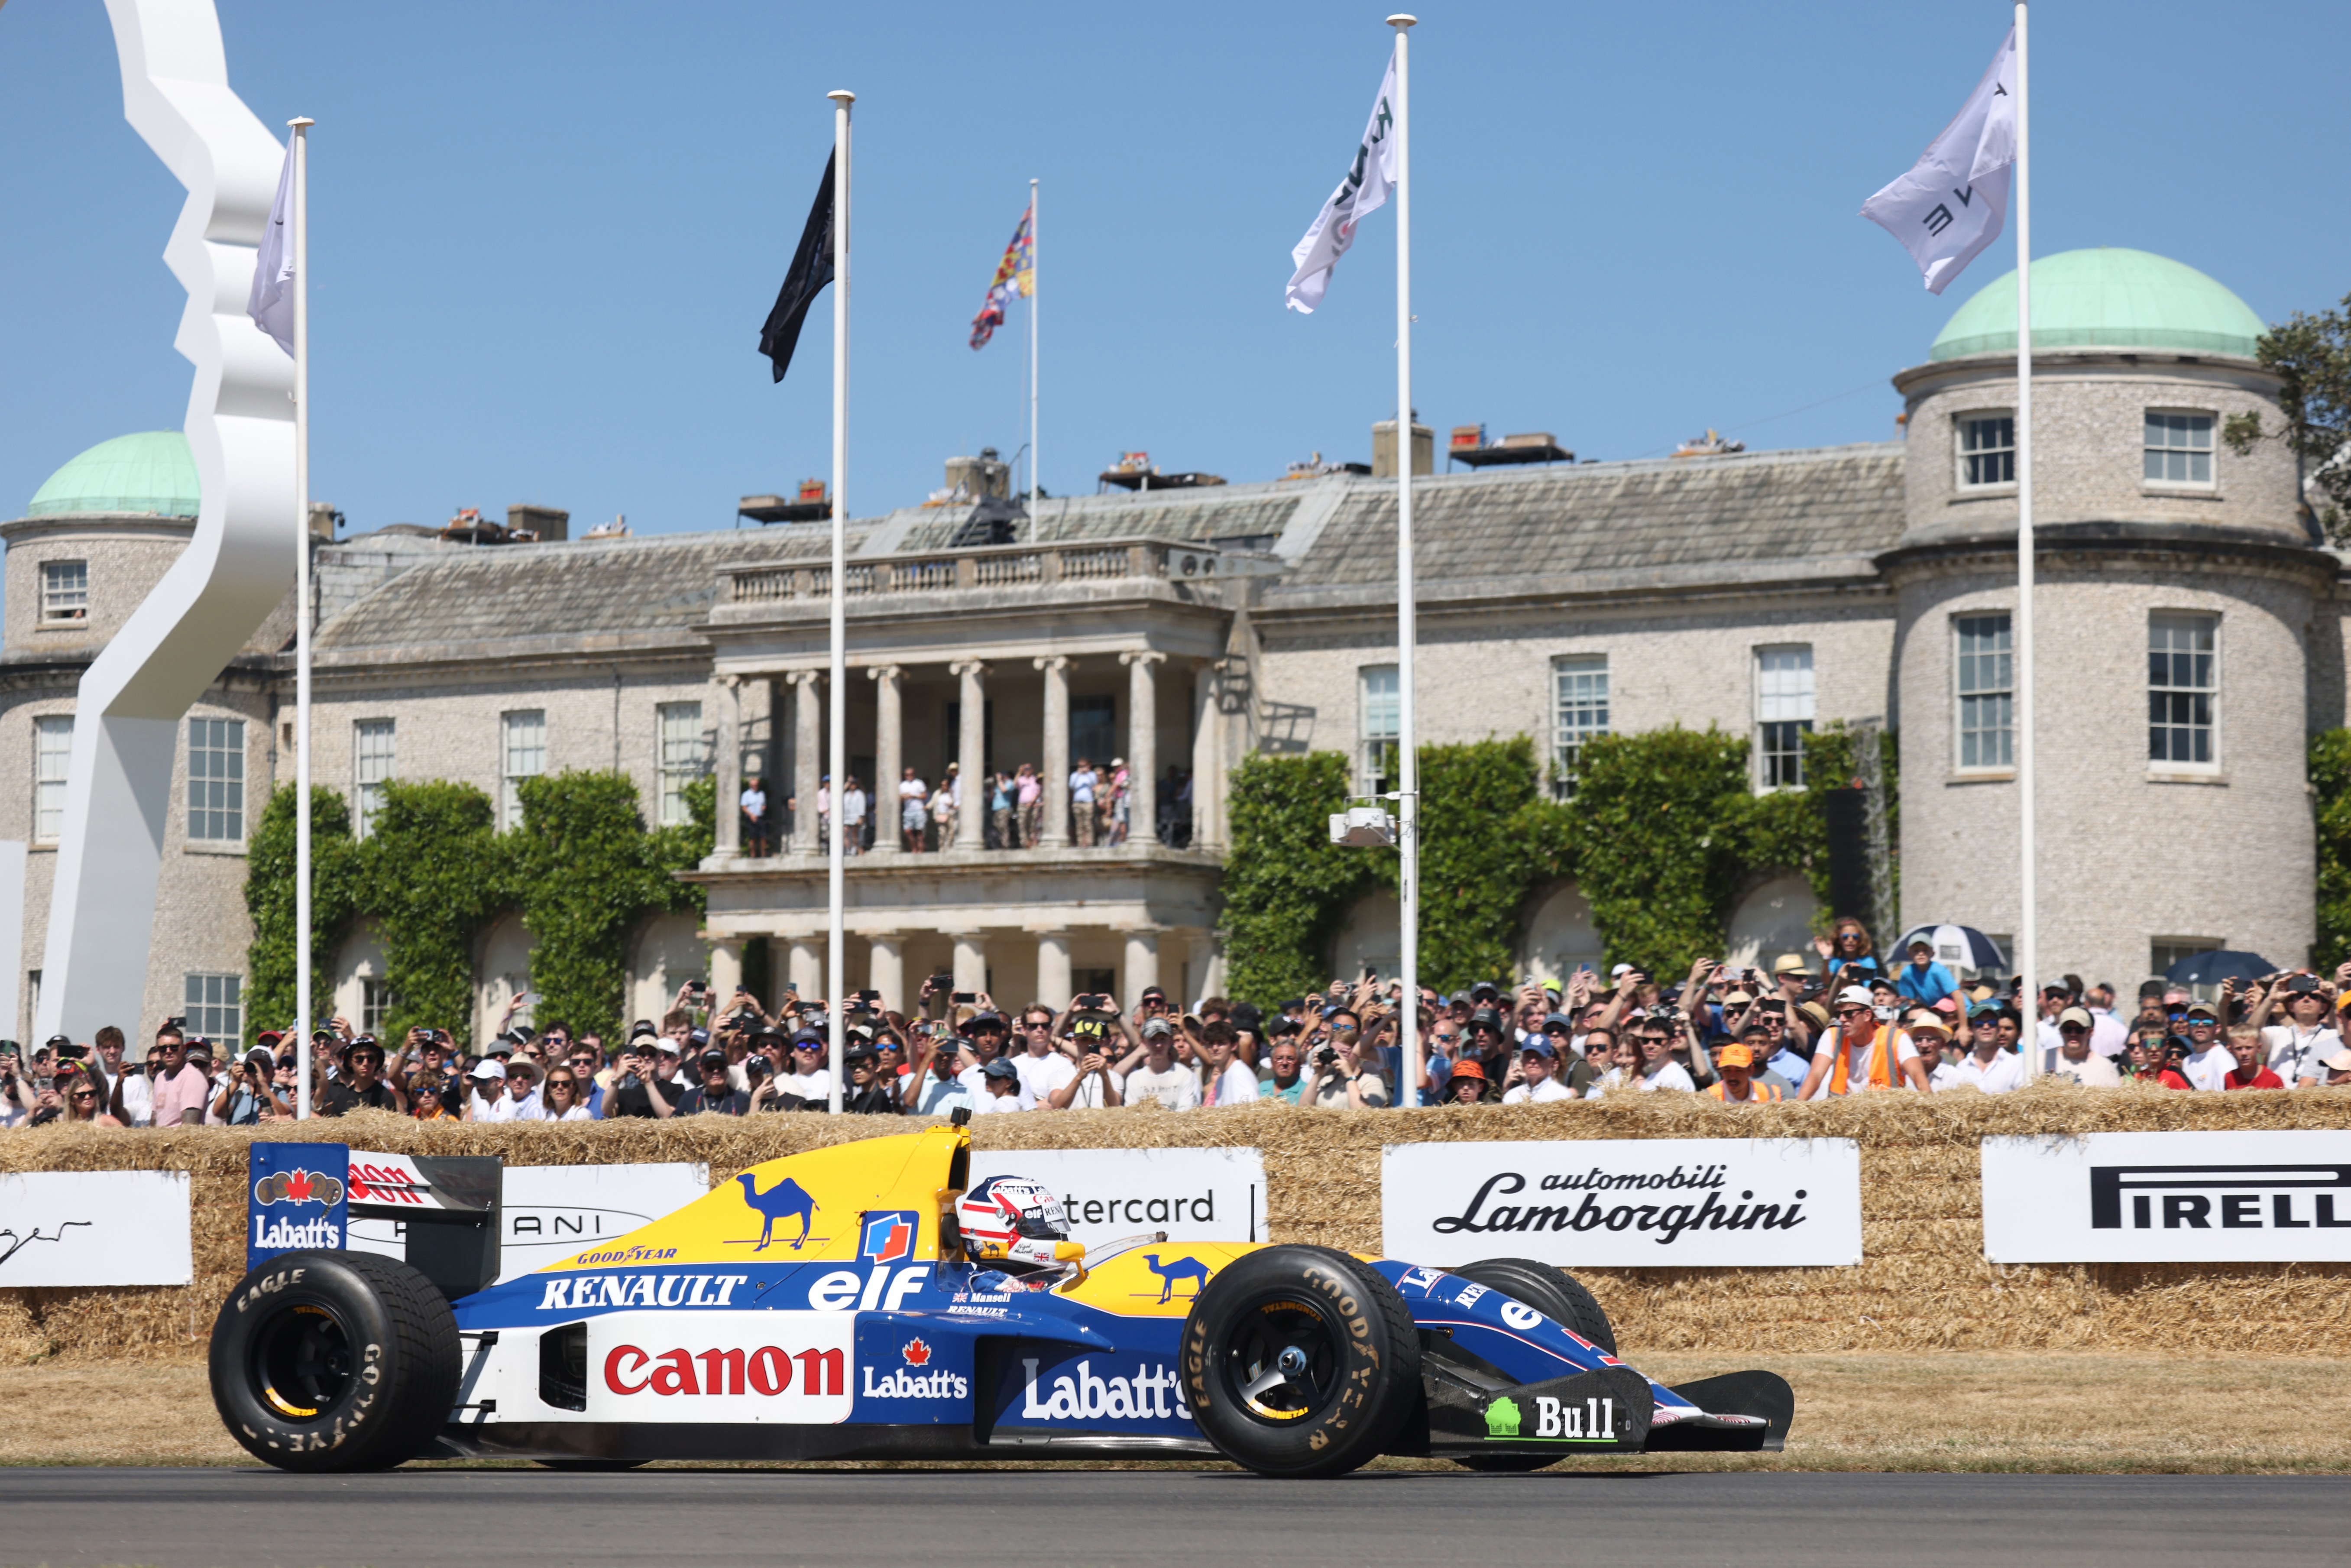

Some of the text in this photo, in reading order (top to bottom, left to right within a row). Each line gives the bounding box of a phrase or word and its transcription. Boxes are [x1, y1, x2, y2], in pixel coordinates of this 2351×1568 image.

[1541, 1165, 1726, 1190] automobili
[1024, 1208, 1043, 1219] elf
[1062, 1189, 1214, 1224] tercard
[1433, 1172, 1808, 1244] Lamborghini
[255, 1215, 340, 1249] Labatt's
[514, 1215, 599, 1235] ANI
[237, 1268, 306, 1313] EAGLE
[535, 1275, 748, 1310] RENAULT
[808, 1266, 930, 1311] elf
[970, 1293, 1011, 1302] Mansell
[946, 1305, 1008, 1315] RENAULT
[604, 1344, 844, 1396] Canon
[1188, 1318, 1208, 1408] EAGLE
[863, 1366, 968, 1399] Labatt's
[1022, 1357, 1193, 1421] Labatt's
[1535, 1396, 1615, 1438] Bull
